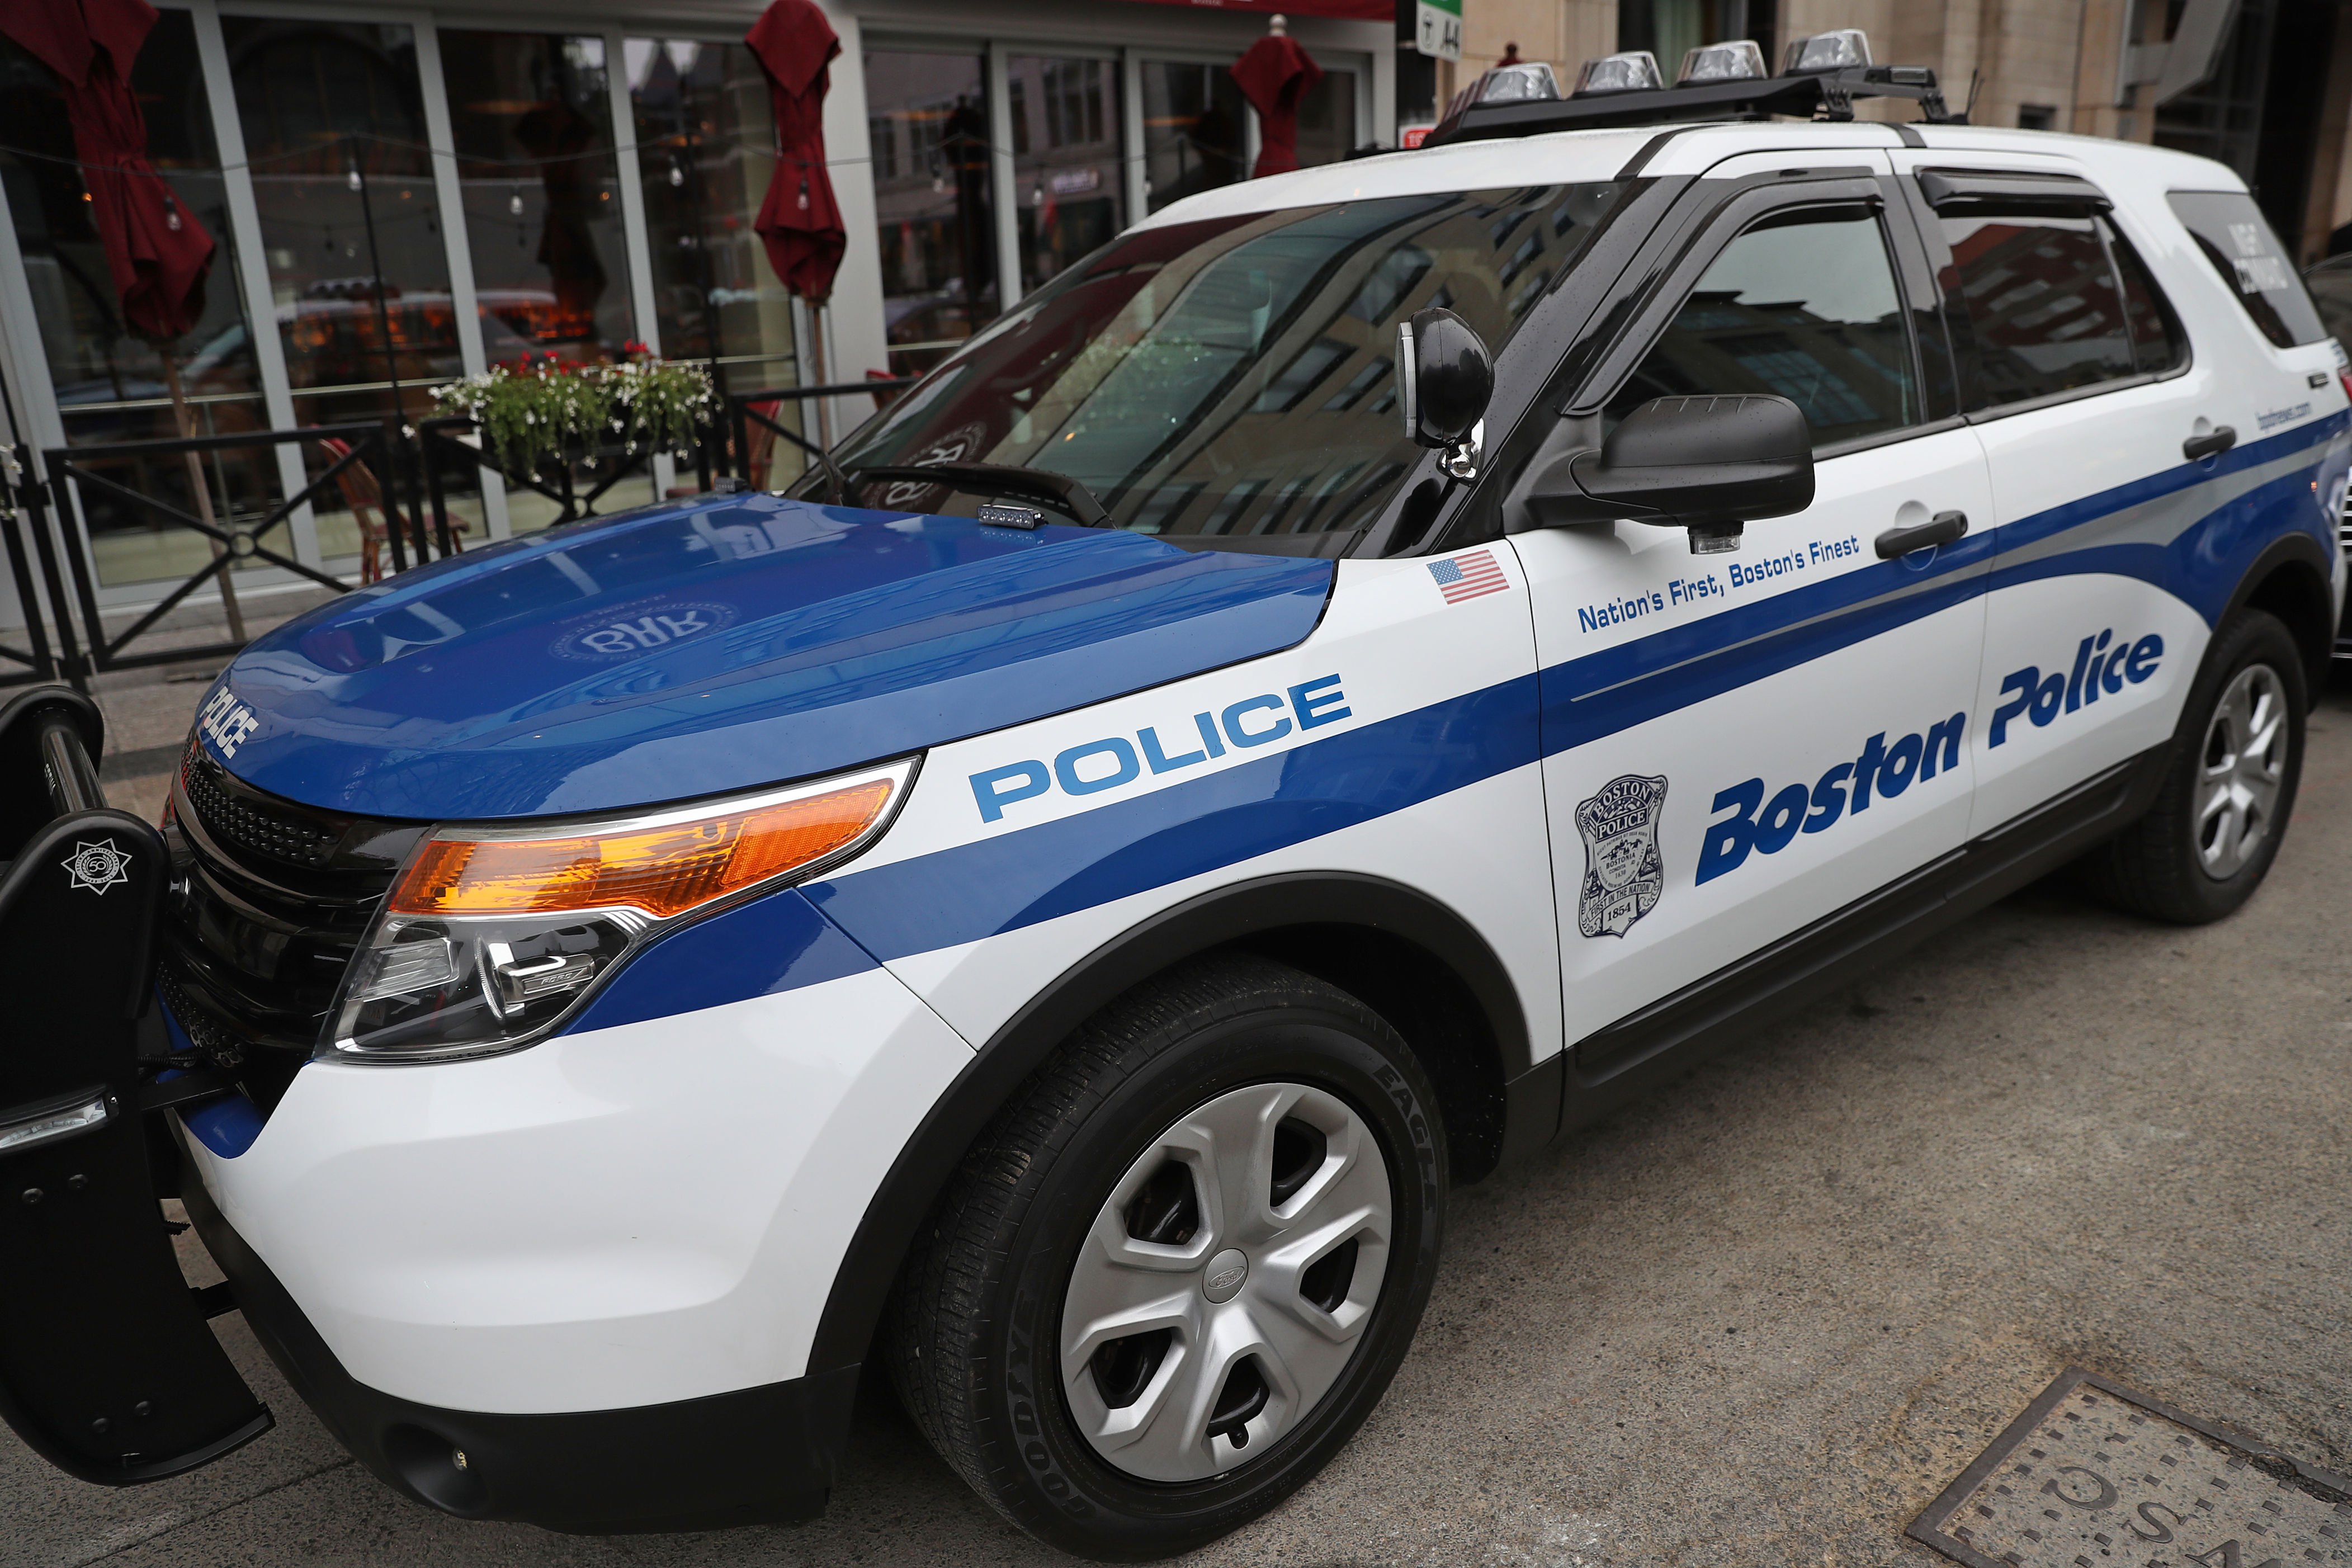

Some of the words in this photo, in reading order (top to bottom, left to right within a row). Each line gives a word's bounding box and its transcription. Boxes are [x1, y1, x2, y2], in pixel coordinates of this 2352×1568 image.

[1578, 590, 1664, 634] Nation's
[1668, 574, 1725, 606] First,
[1729, 551, 1805, 588] Boston's
[1808, 535, 1859, 565] Finest
[200, 686, 259, 759] POLICE
[968, 673, 1352, 824] POLICE
[1695, 711, 1966, 887] Boston
[1989, 628, 2164, 749] Police
[1595, 782, 1650, 818] BOSTON
[1598, 810, 1646, 839] POLICE
[87, 848, 119, 867] ANNIVERSARY
[89, 861, 107, 872] 50
[1606, 852, 1636, 869] BOSTONIA
[1590, 900, 1606, 919] FIRST
[1608, 893, 1616, 904] IN
[1616, 888, 1628, 901] THE
[1628, 882, 1650, 895] NATION
[1607, 901, 1632, 922] 1854
[1372, 1063, 1438, 1214] EAGLE
[1216, 1270, 1240, 1287] Ford
